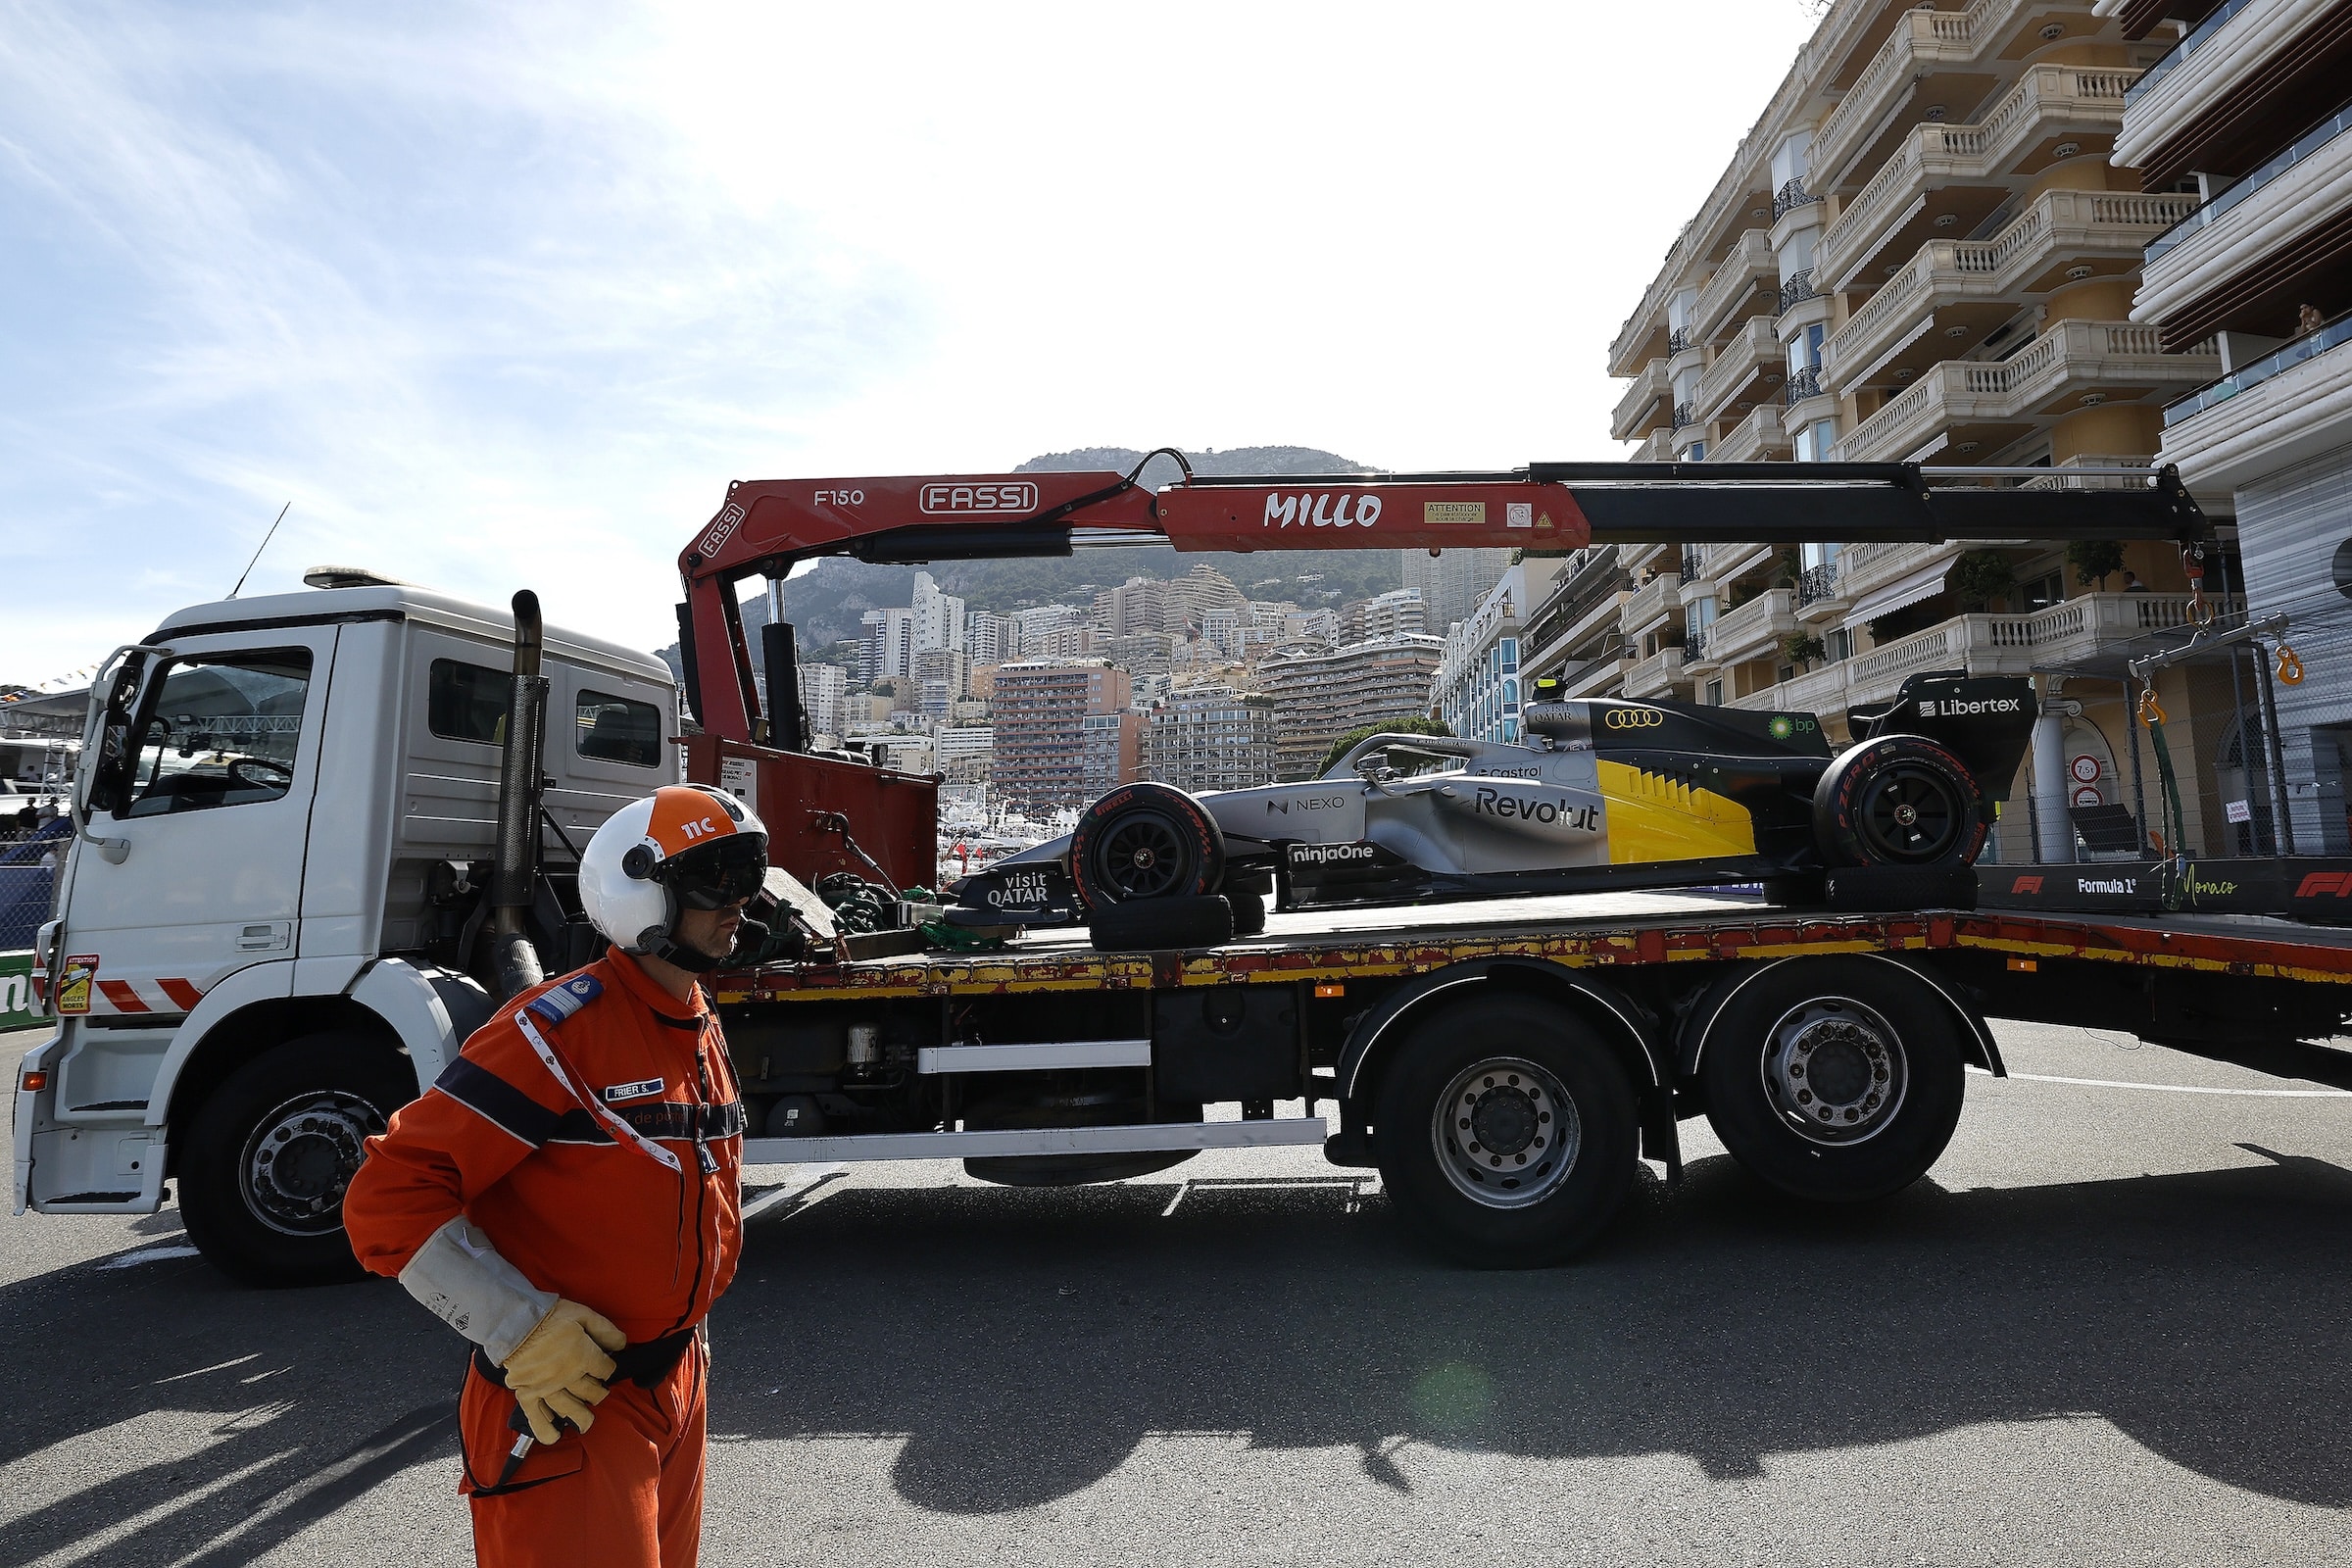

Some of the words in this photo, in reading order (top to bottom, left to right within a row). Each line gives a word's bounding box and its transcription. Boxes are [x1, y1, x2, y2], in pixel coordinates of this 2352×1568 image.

[813, 490, 864, 507] F150
[928, 486, 1029, 509] FASSI
[1428, 504, 1481, 513] ATTENTION
[703, 508, 741, 553] FASSI
[1939, 697, 2021, 716] Libertex
[1535, 711, 1572, 724] QATAR
[1794, 717, 1815, 734] bp
[1490, 765, 1542, 778] Castrol
[1838, 752, 1875, 809] ZERO
[1095, 789, 1135, 817] PIRELLI
[1297, 796, 1345, 811] NEXO
[1475, 787, 1599, 832] Revolut
[680, 816, 716, 840] 11C
[1294, 845, 1374, 864] ninjaOne
[1004, 871, 1047, 888] visit
[2078, 878, 2124, 894] Formula
[987, 887, 1049, 907] QATAR
[613, 1085, 639, 1098] FRIER
[634, 1111, 652, 1125] de
